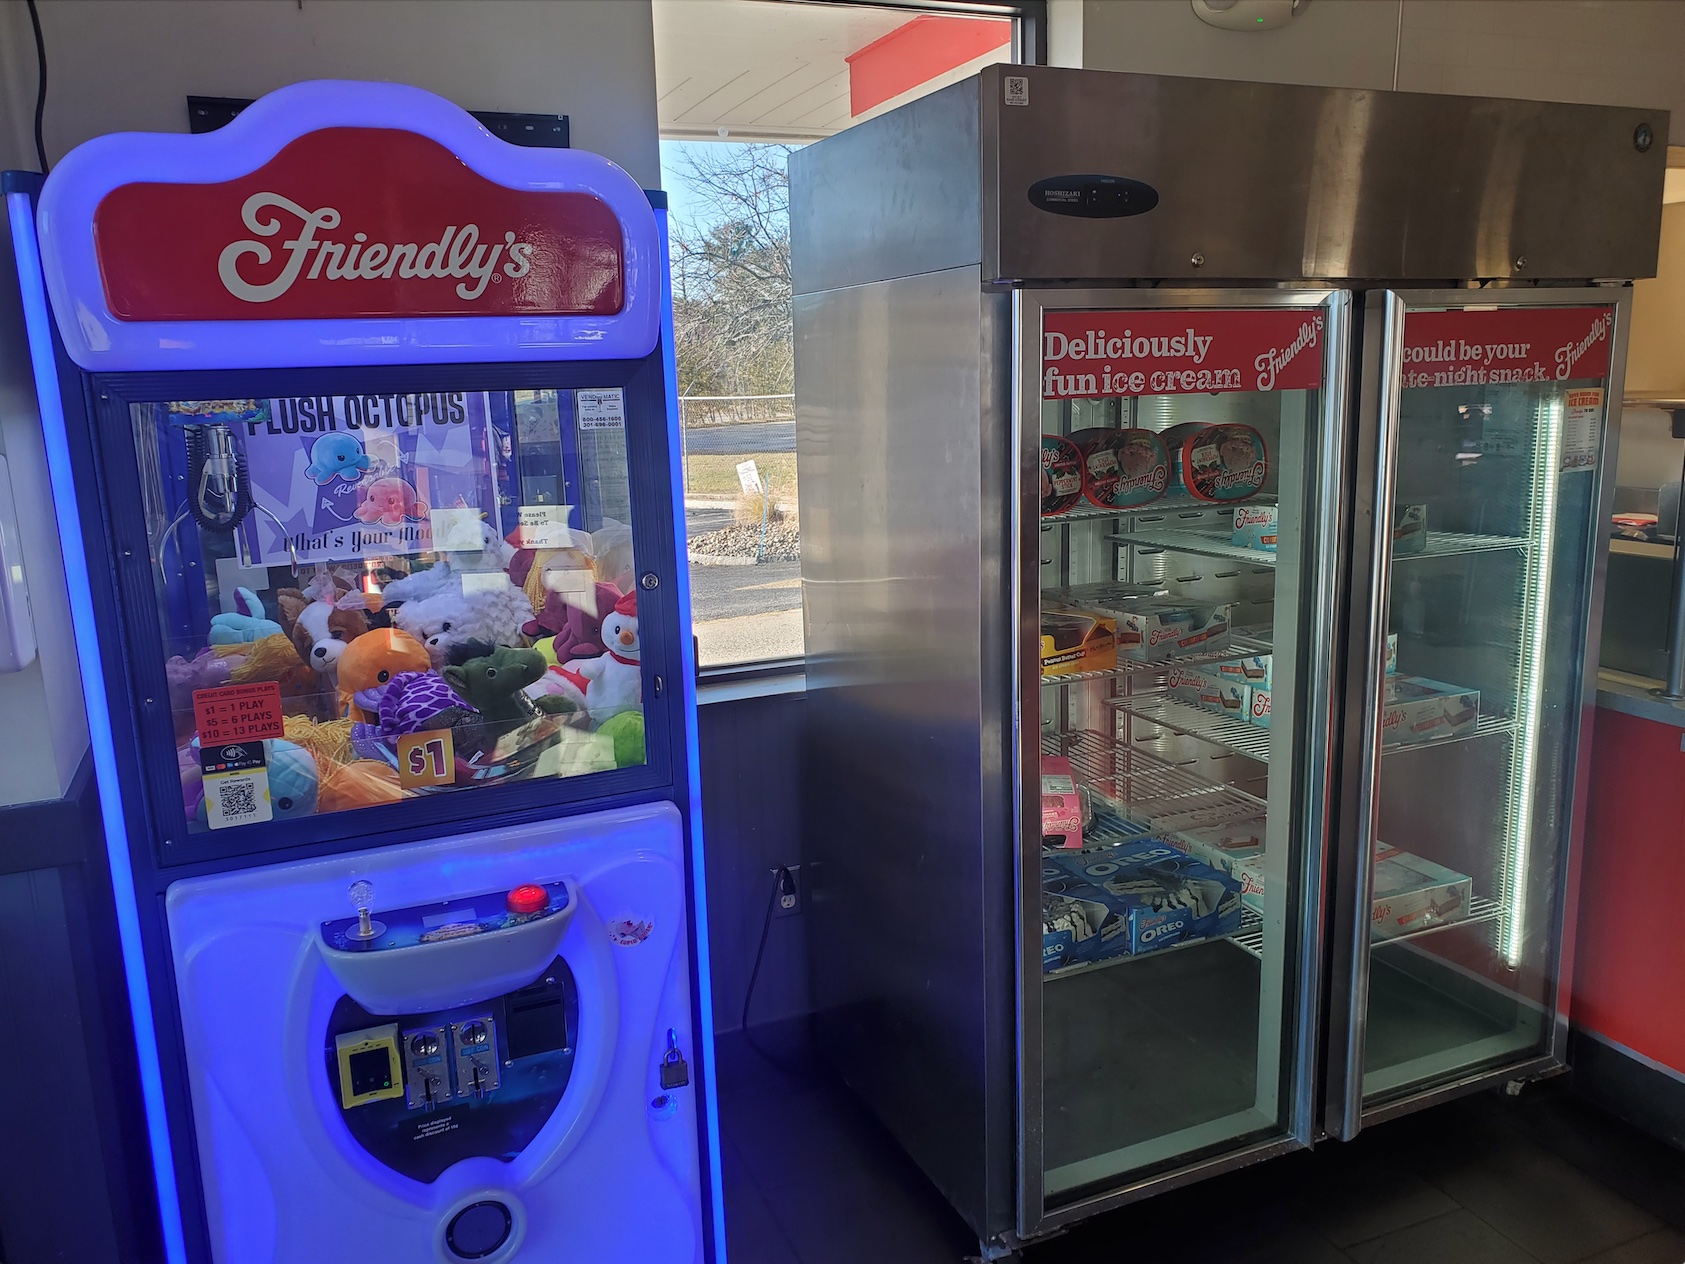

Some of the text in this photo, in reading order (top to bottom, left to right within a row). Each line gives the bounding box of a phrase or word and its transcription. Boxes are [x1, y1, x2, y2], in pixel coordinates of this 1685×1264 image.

[217, 191, 534, 302] Friendly's
[1044, 328, 1213, 364] Deliciously
[1254, 315, 1324, 392] Friendly's
[1403, 339, 1531, 366] could be your
[1555, 312, 1612, 380] Friendly's
[1044, 365, 1242, 396] fun ice cream
[344, 392, 466, 430] OCTOPUS
[334, 463, 397, 497] Reversible
[1112, 465, 1166, 495] Friendly's
[1214, 461, 1264, 490] Friendly's
[1235, 508, 1272, 529] Friendly's
[283, 528, 344, 553] What's
[350, 530, 393, 554] Your
[1150, 627, 1184, 646] Friendly's
[1170, 668, 1207, 692] Friendly's
[205, 706, 215, 715] $1
[240, 700, 264, 710] PLAY
[206, 718, 218, 726] $5
[241, 711, 272, 723] PLAYS
[202, 730, 219, 739] $10
[234, 726, 245, 735] 13
[248, 722, 280, 733] PLAYS
[408, 738, 447, 778] $1
[1085, 848, 1172, 876] OREO
[1140, 920, 1184, 943] OREO
